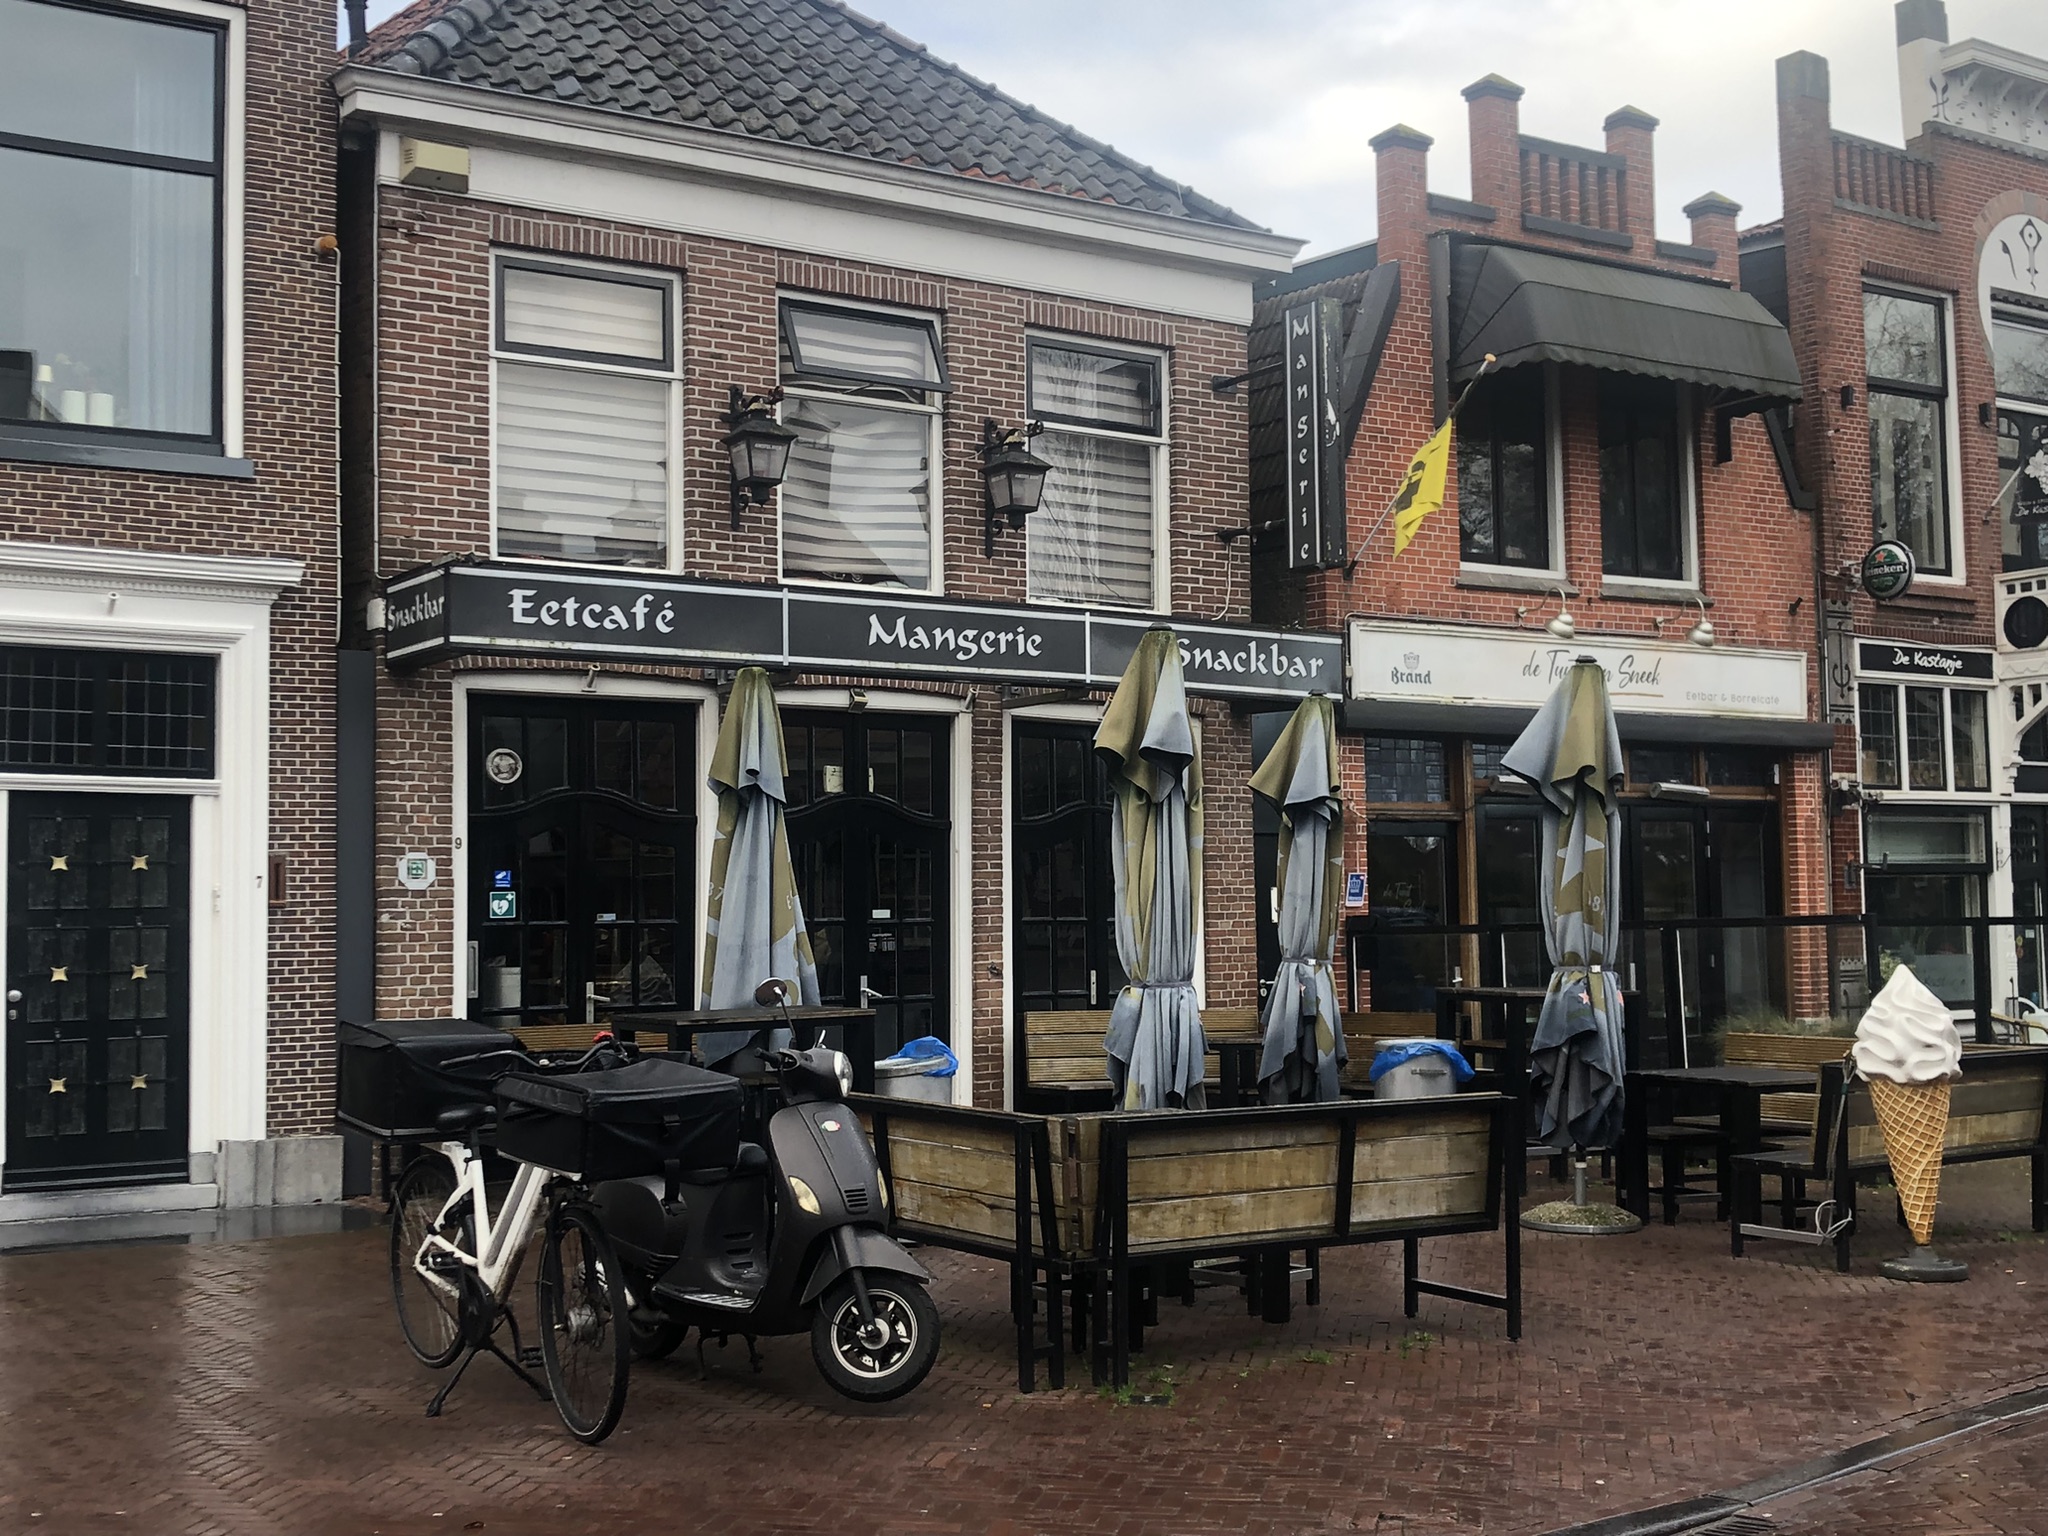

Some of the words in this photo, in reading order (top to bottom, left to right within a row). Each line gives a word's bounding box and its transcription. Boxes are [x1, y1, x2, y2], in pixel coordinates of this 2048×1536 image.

[387, 591, 445, 632] Snackbar
[507, 588, 675, 634] Eetcafé
[868, 613, 1043, 661] Mangerie
[1176, 637, 1324, 679] Snackbar
[1522, 649, 1542, 677] de
[1618, 654, 1662, 689] Sneek
[1892, 647, 1911, 666] De
[1913, 650, 1964, 676] Kastanje
[1391, 666, 1432, 685] Brand
[1685, 690, 1718, 702] Eetbar
[1720, 692, 1728, 703] &
[454, 836, 463, 850] 9
[255, 875, 263, 889] 7
